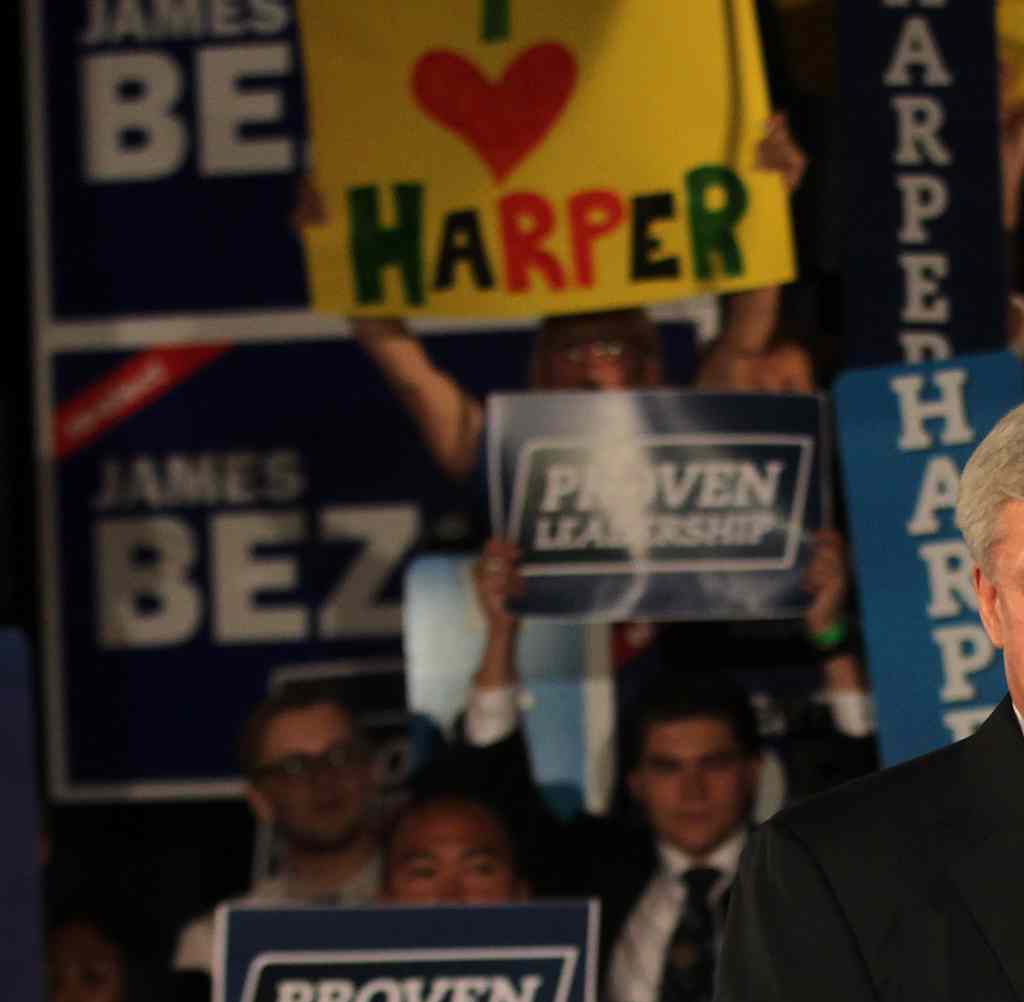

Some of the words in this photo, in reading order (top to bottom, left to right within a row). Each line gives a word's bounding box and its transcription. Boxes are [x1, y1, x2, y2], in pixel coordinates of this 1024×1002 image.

[881, 0, 956, 366] ARPE
[348, 164, 750, 306] HARPER
[94, 448, 308, 512] JAMES
[541, 459, 786, 513] PVEN
